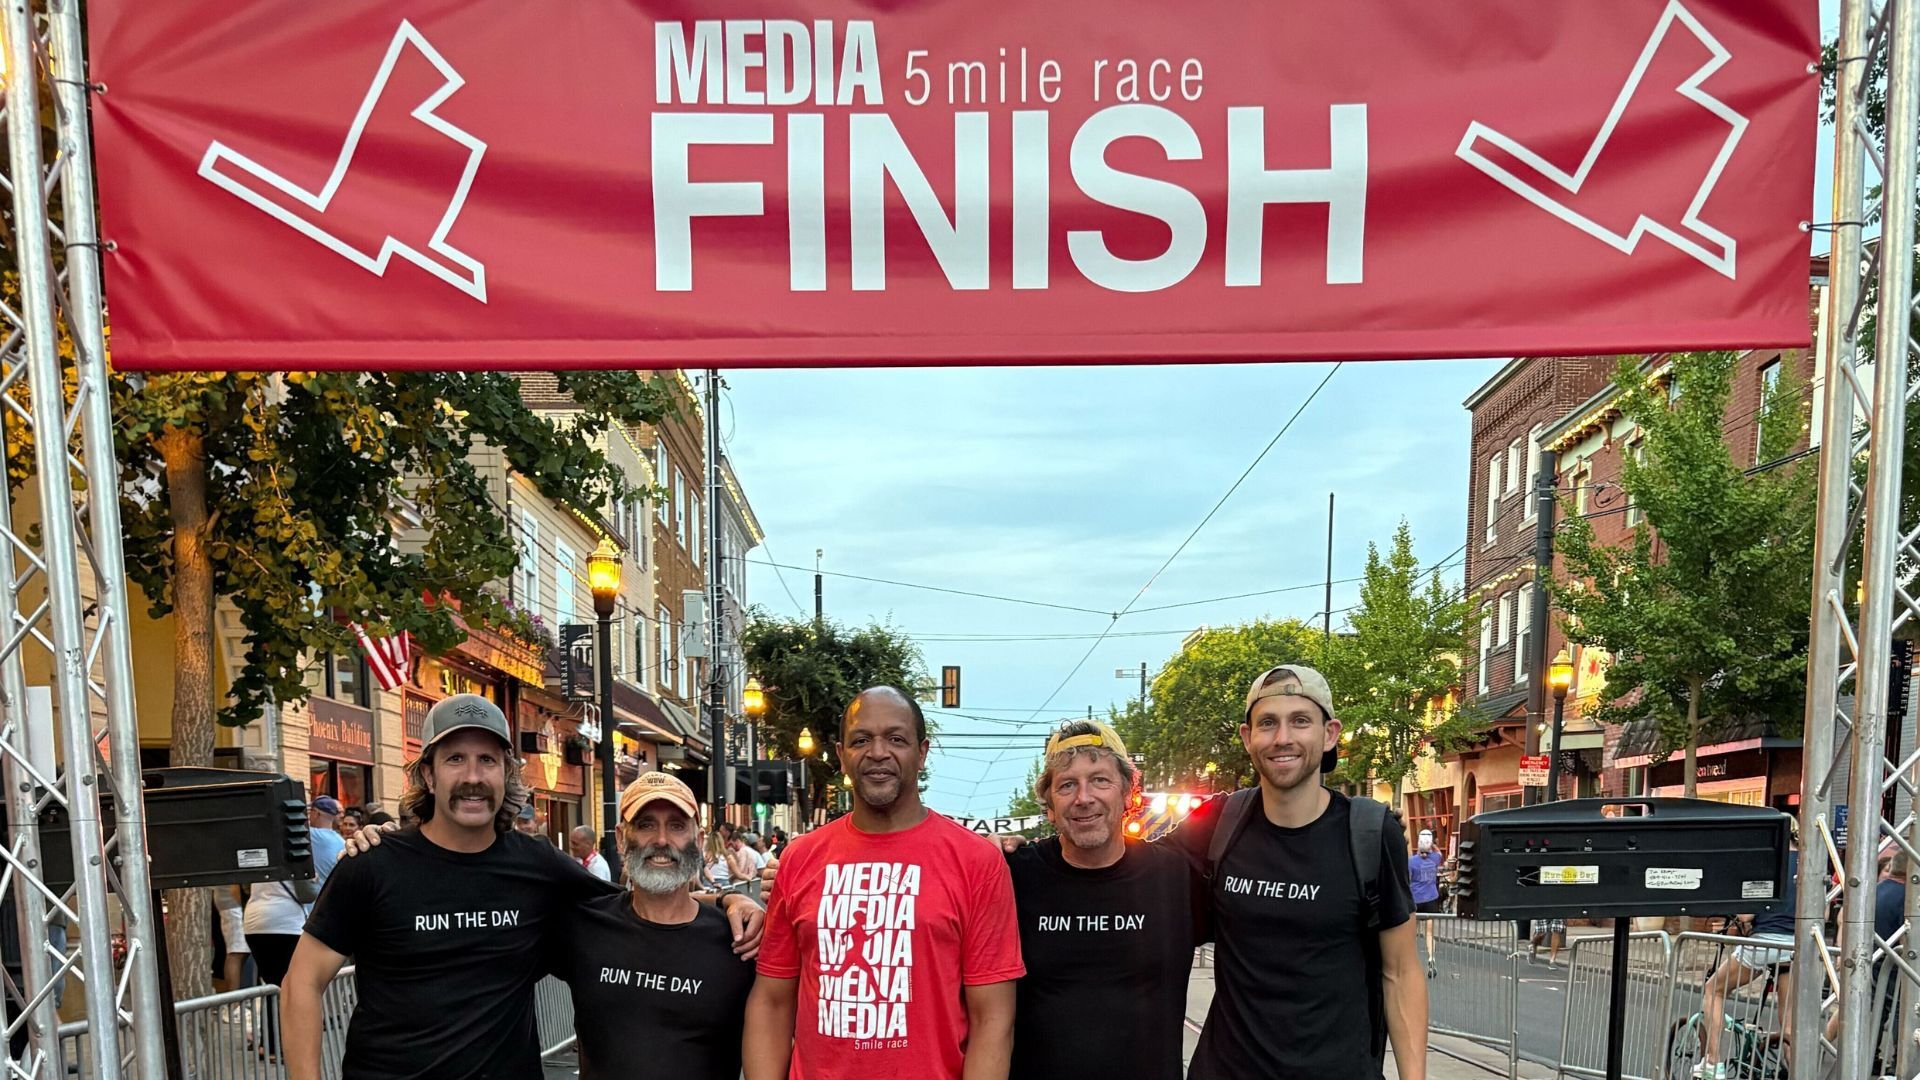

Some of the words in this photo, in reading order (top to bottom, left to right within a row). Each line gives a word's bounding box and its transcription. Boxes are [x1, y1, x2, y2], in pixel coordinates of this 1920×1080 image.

[655, 20, 885, 106] MEDIA
[1095, 57, 1204, 101] race
[651, 103, 1368, 292] FINISH
[560, 626, 568, 656] STATE
[1904, 641, 1914, 670] STATE
[561, 660, 569, 697] STREET
[1900, 675, 1911, 711] STREET
[309, 713, 339, 741] Phoenix
[341, 720, 371, 755] Building
[942, 814, 1031, 833] TART
[823, 862, 921, 896] MEDIA
[1224, 876, 1253, 895] RUN
[1257, 880, 1286, 898] THE
[1288, 883, 1320, 901] DAY
[415, 913, 449, 931] RUN
[454, 911, 487, 928] THE
[491, 910, 519, 926] DAY
[817, 895, 916, 930] MEDIA
[1038, 916, 1071, 931] RUN
[1076, 916, 1109, 931] THE
[1114, 915, 1145, 930] DAY
[817, 928, 913, 967] MDIA
[600, 967, 631, 985] RUN
[636, 971, 667, 990] THE
[670, 977, 702, 995] DAY
[817, 999, 908, 1040] MEDIA
[886, 1038, 908, 1049] race
